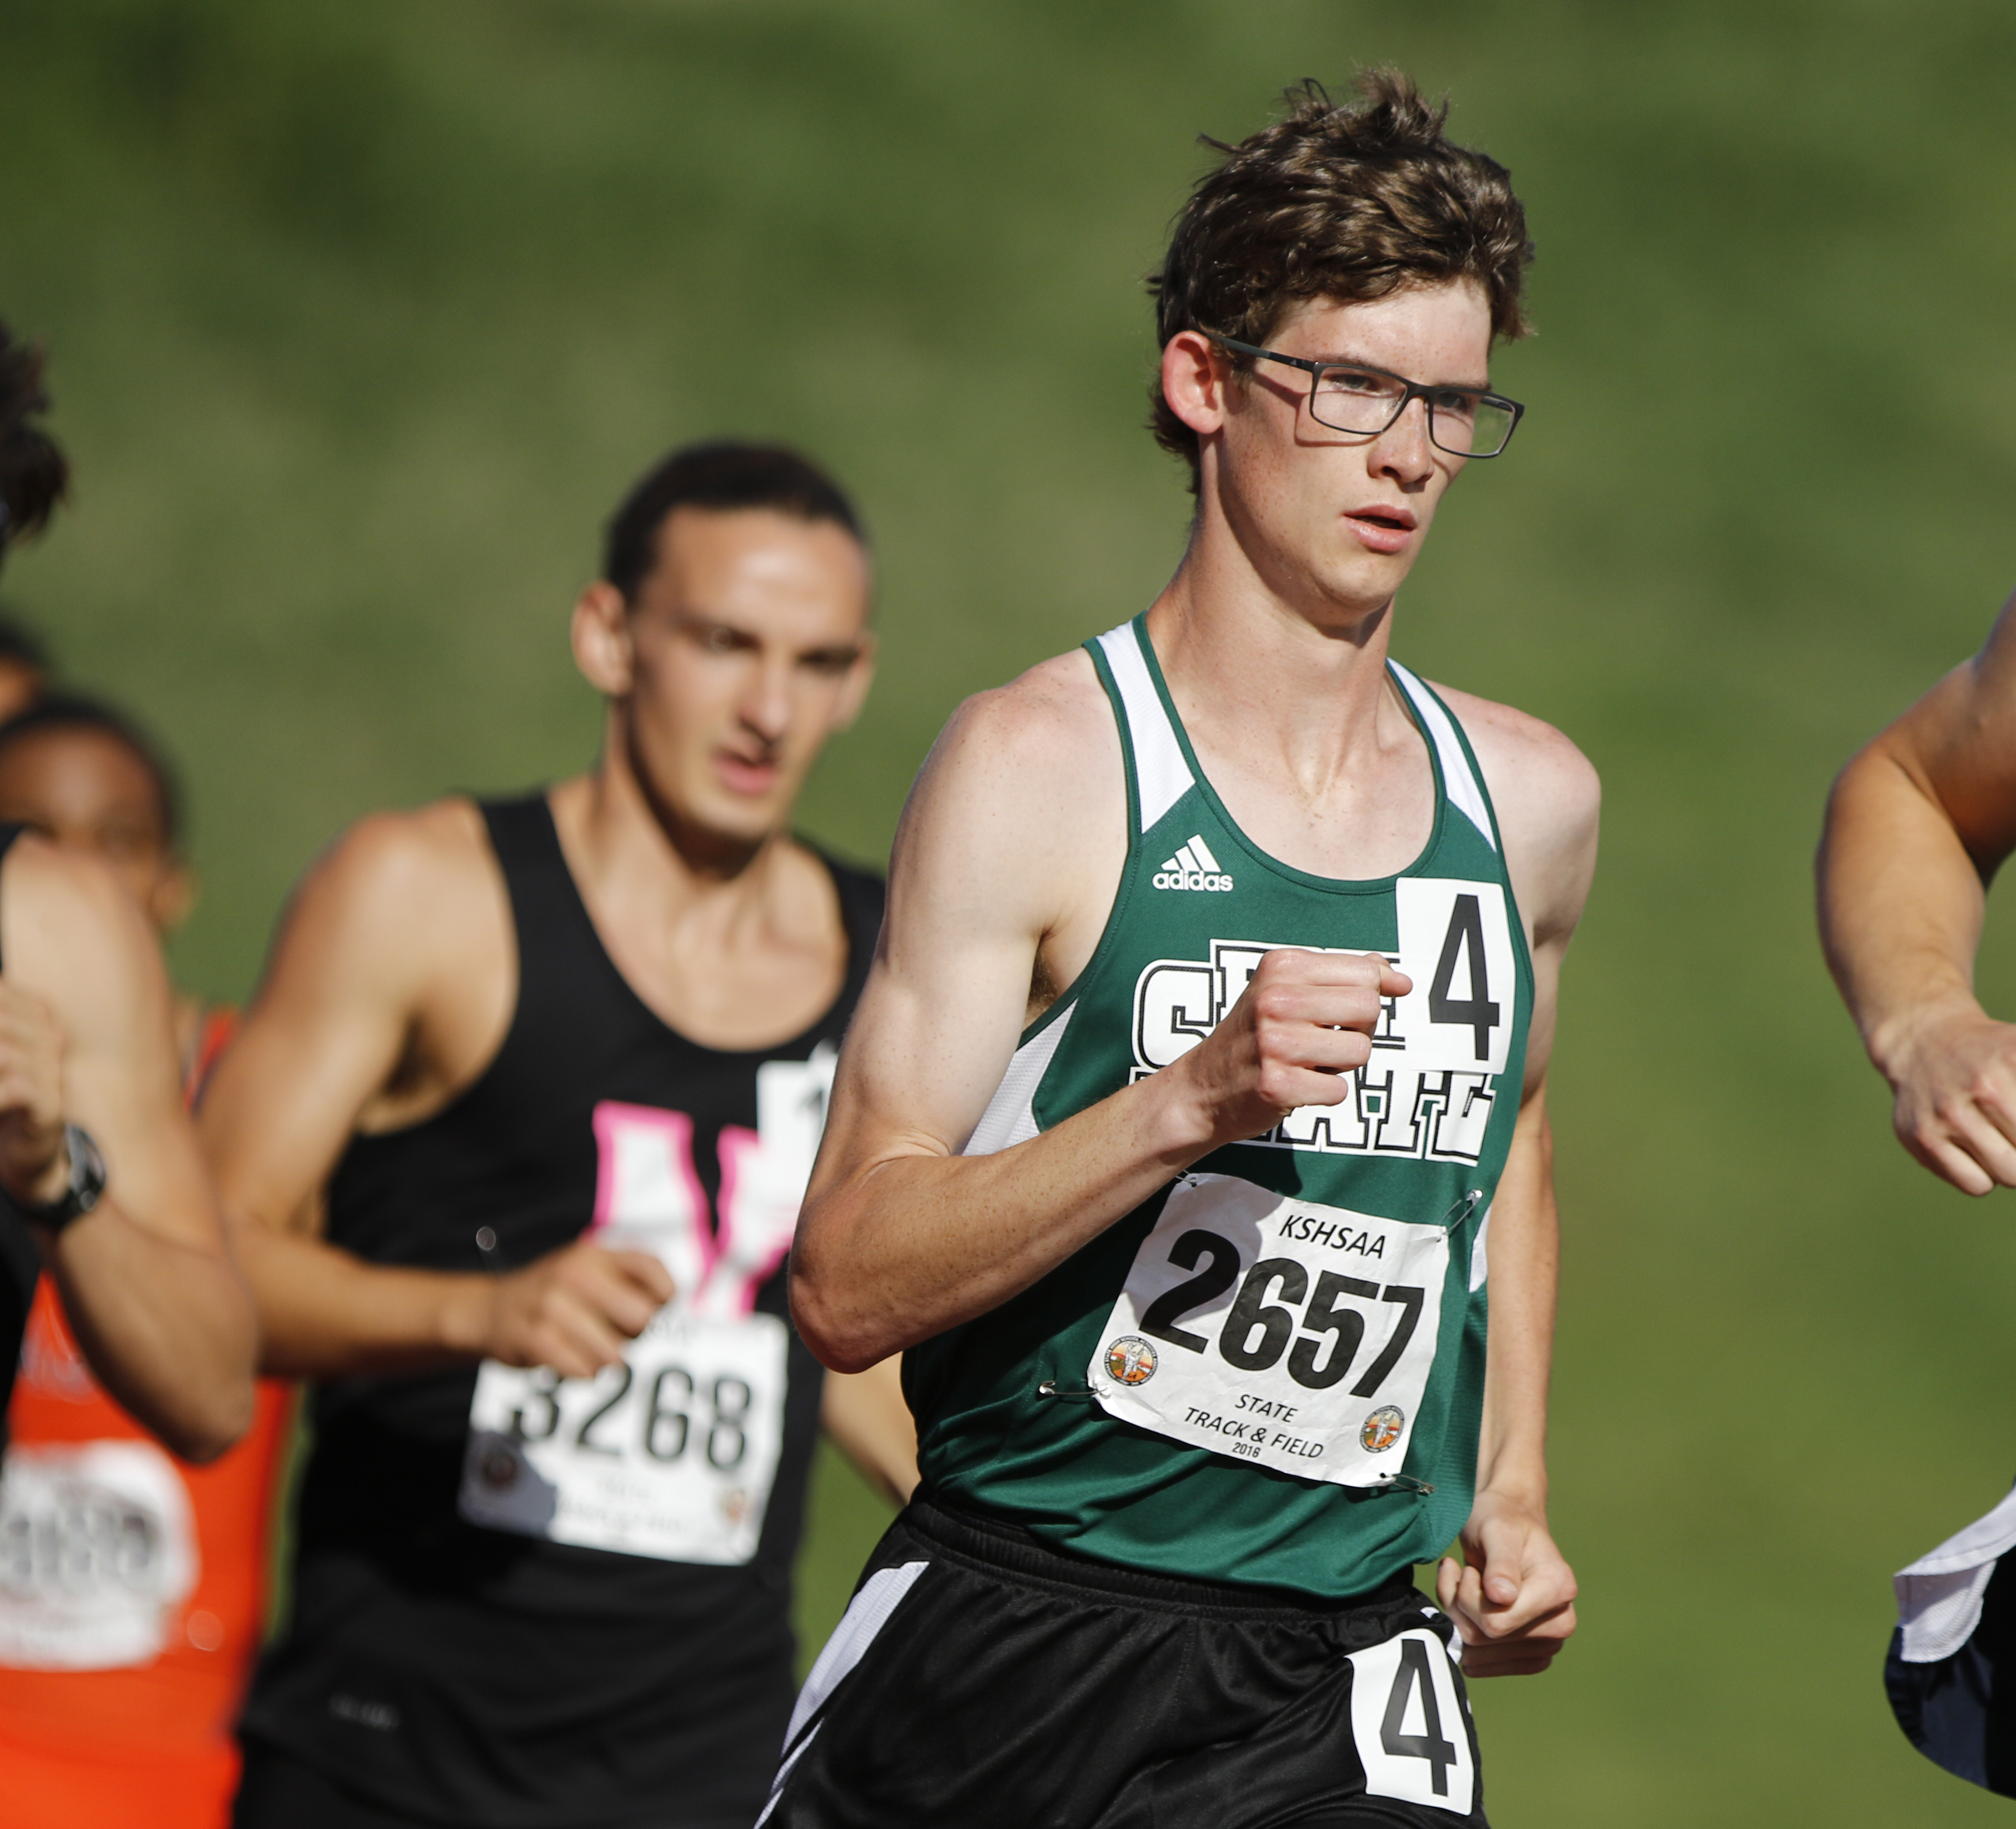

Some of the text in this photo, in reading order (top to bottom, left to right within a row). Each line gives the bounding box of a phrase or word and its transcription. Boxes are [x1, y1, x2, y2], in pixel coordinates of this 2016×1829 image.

[1152, 869, 1234, 892] adidas
[1430, 894, 1499, 1060] 4
[1279, 1215, 1387, 1260] KSHSAA
[1139, 1228, 1425, 1399] 2657
[512, 1364, 751, 1472] 3268
[1184, 1407, 1324, 1458] TRACK & FIELD
[1234, 1394, 1298, 1423] STATE
[1231, 1442, 1261, 1458] 2016
[1380, 1638, 1457, 1797] 4
